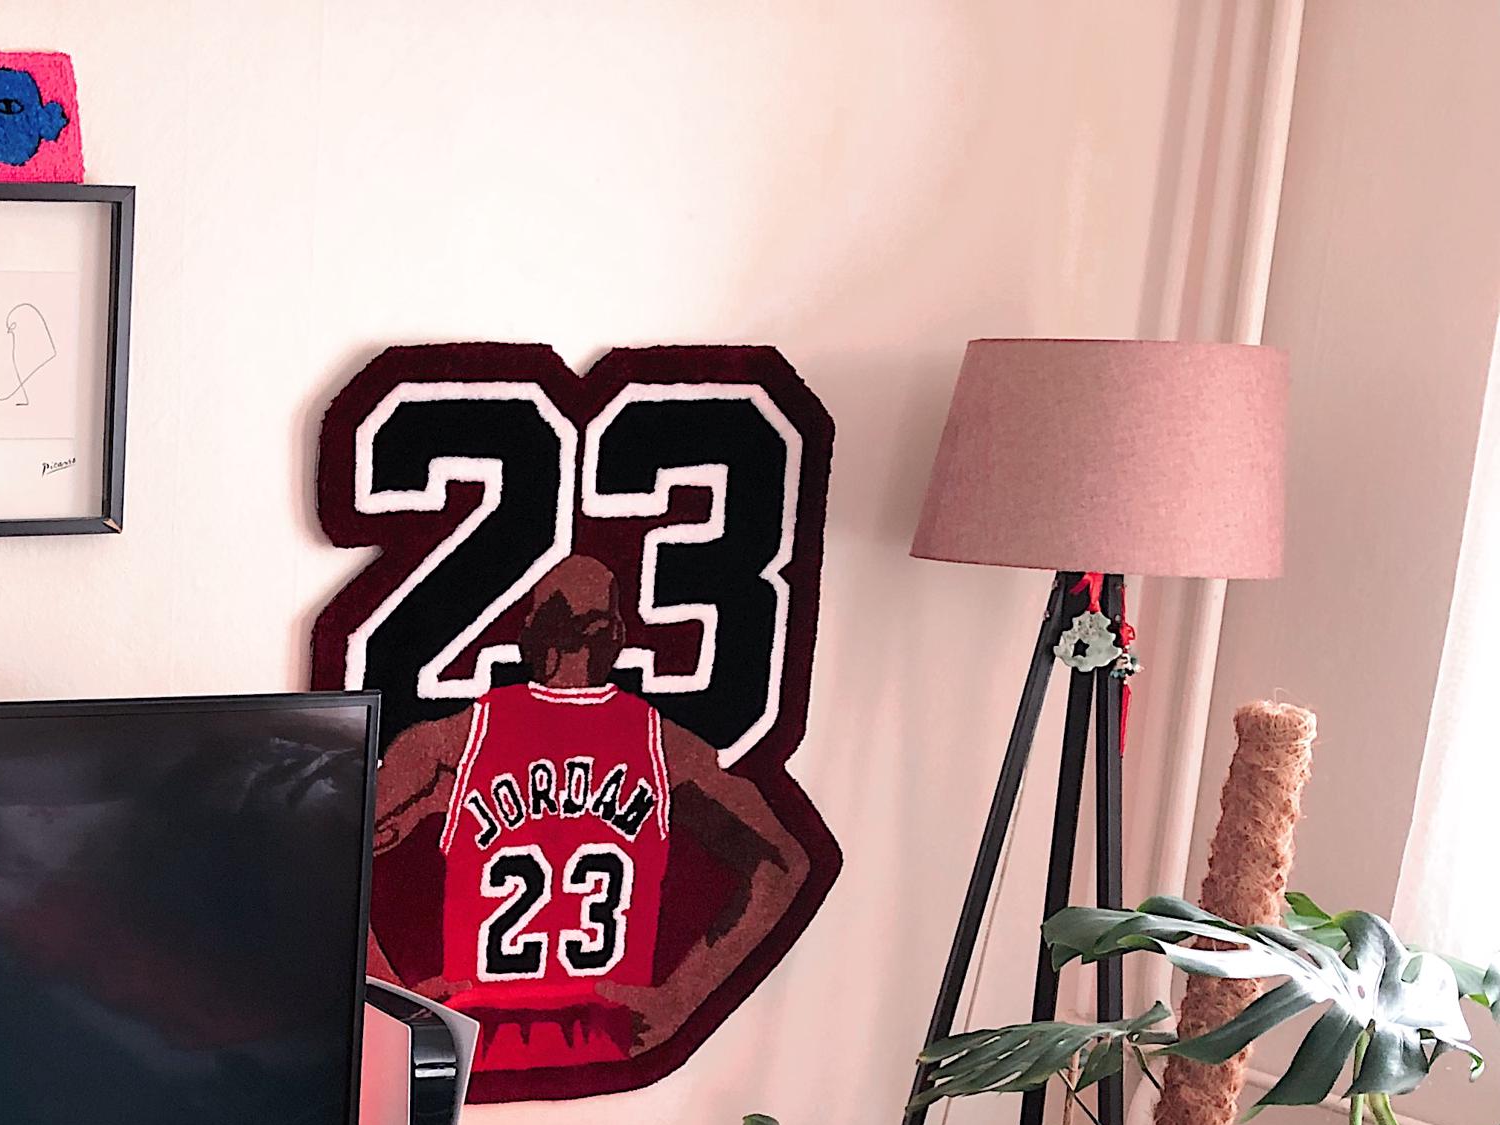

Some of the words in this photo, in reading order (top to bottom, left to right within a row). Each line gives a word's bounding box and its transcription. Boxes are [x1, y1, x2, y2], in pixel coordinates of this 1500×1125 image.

[346, 380, 802, 770] 23
[467, 754, 657, 849] JORDAN
[476, 843, 635, 982] 23
